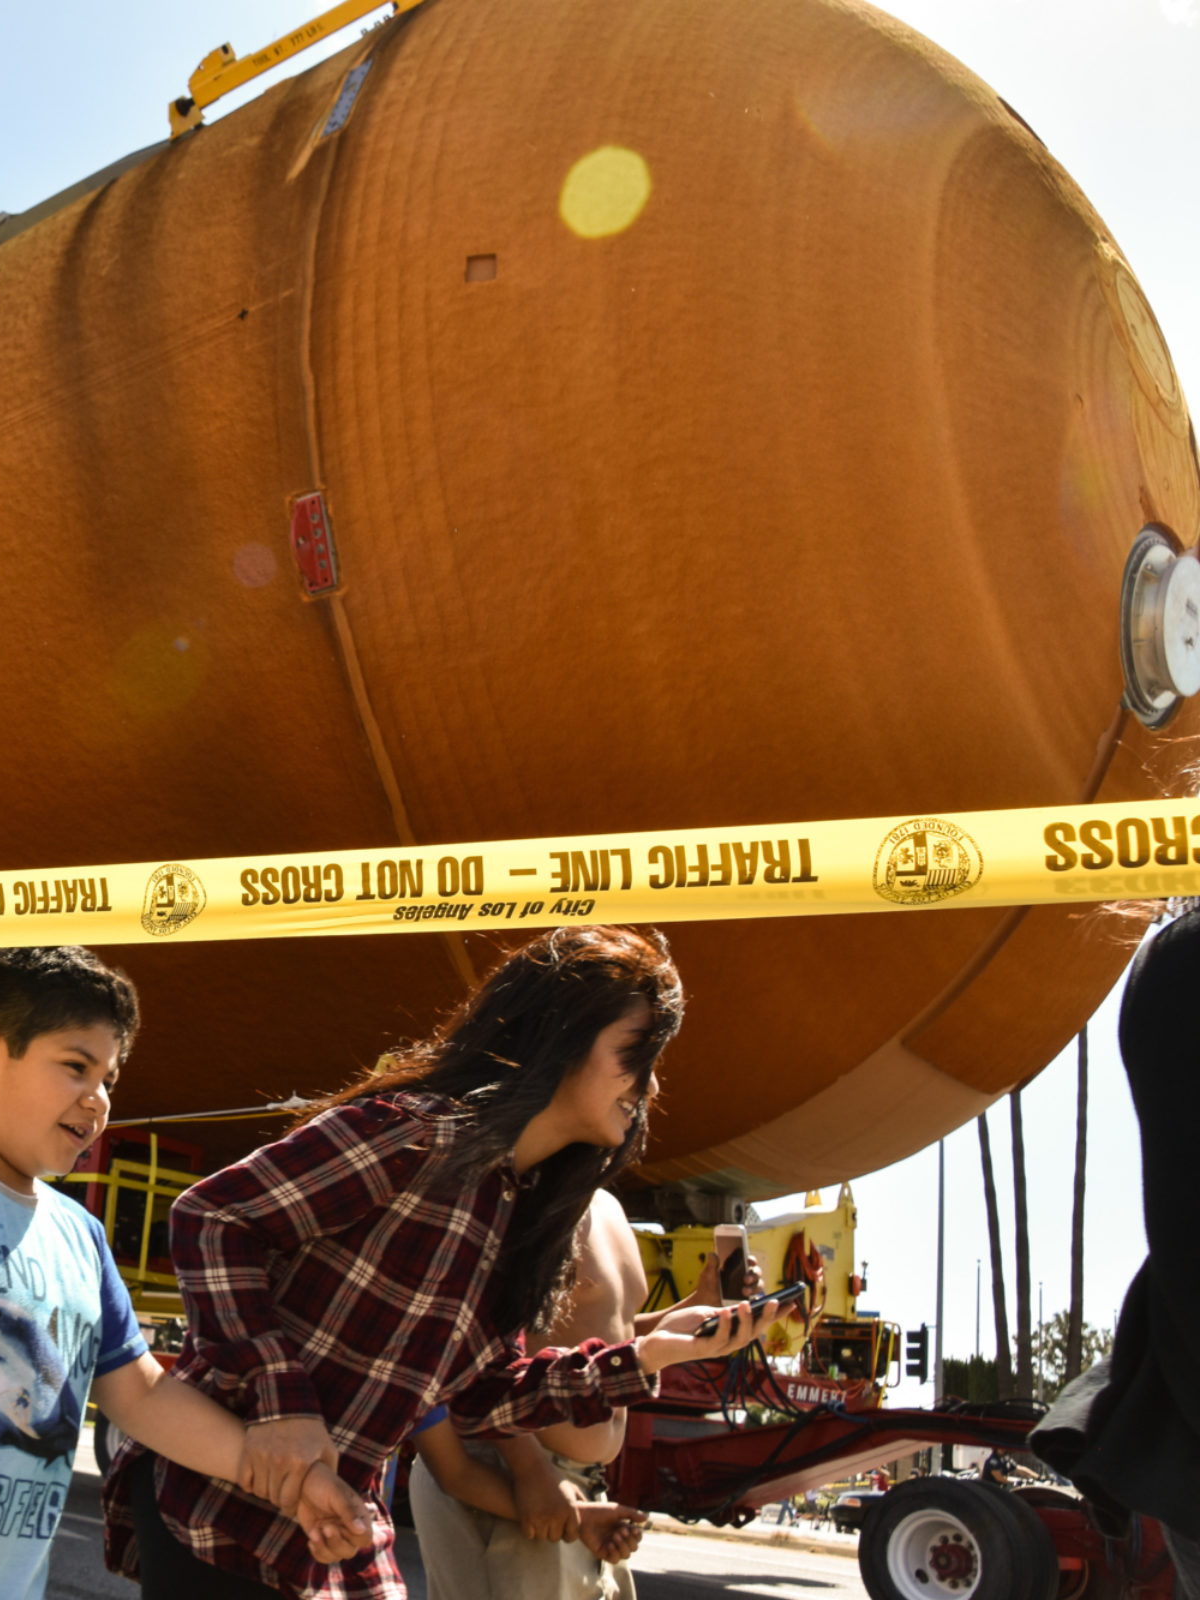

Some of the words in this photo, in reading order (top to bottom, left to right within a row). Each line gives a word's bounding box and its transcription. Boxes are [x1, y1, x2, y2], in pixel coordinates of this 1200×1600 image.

[356, 858, 423, 901] NOT
[437, 856, 484, 898] DO
[549, 848, 632, 893] LINE
[648, 838, 819, 890] TRAFFIC
[13, 877, 112, 916] TRAFFIC
[240, 863, 344, 906] CROSS
[393, 902, 475, 922] Angeles
[478, 901, 514, 920] Los
[519, 900, 544, 919] of
[550, 897, 596, 917] City
